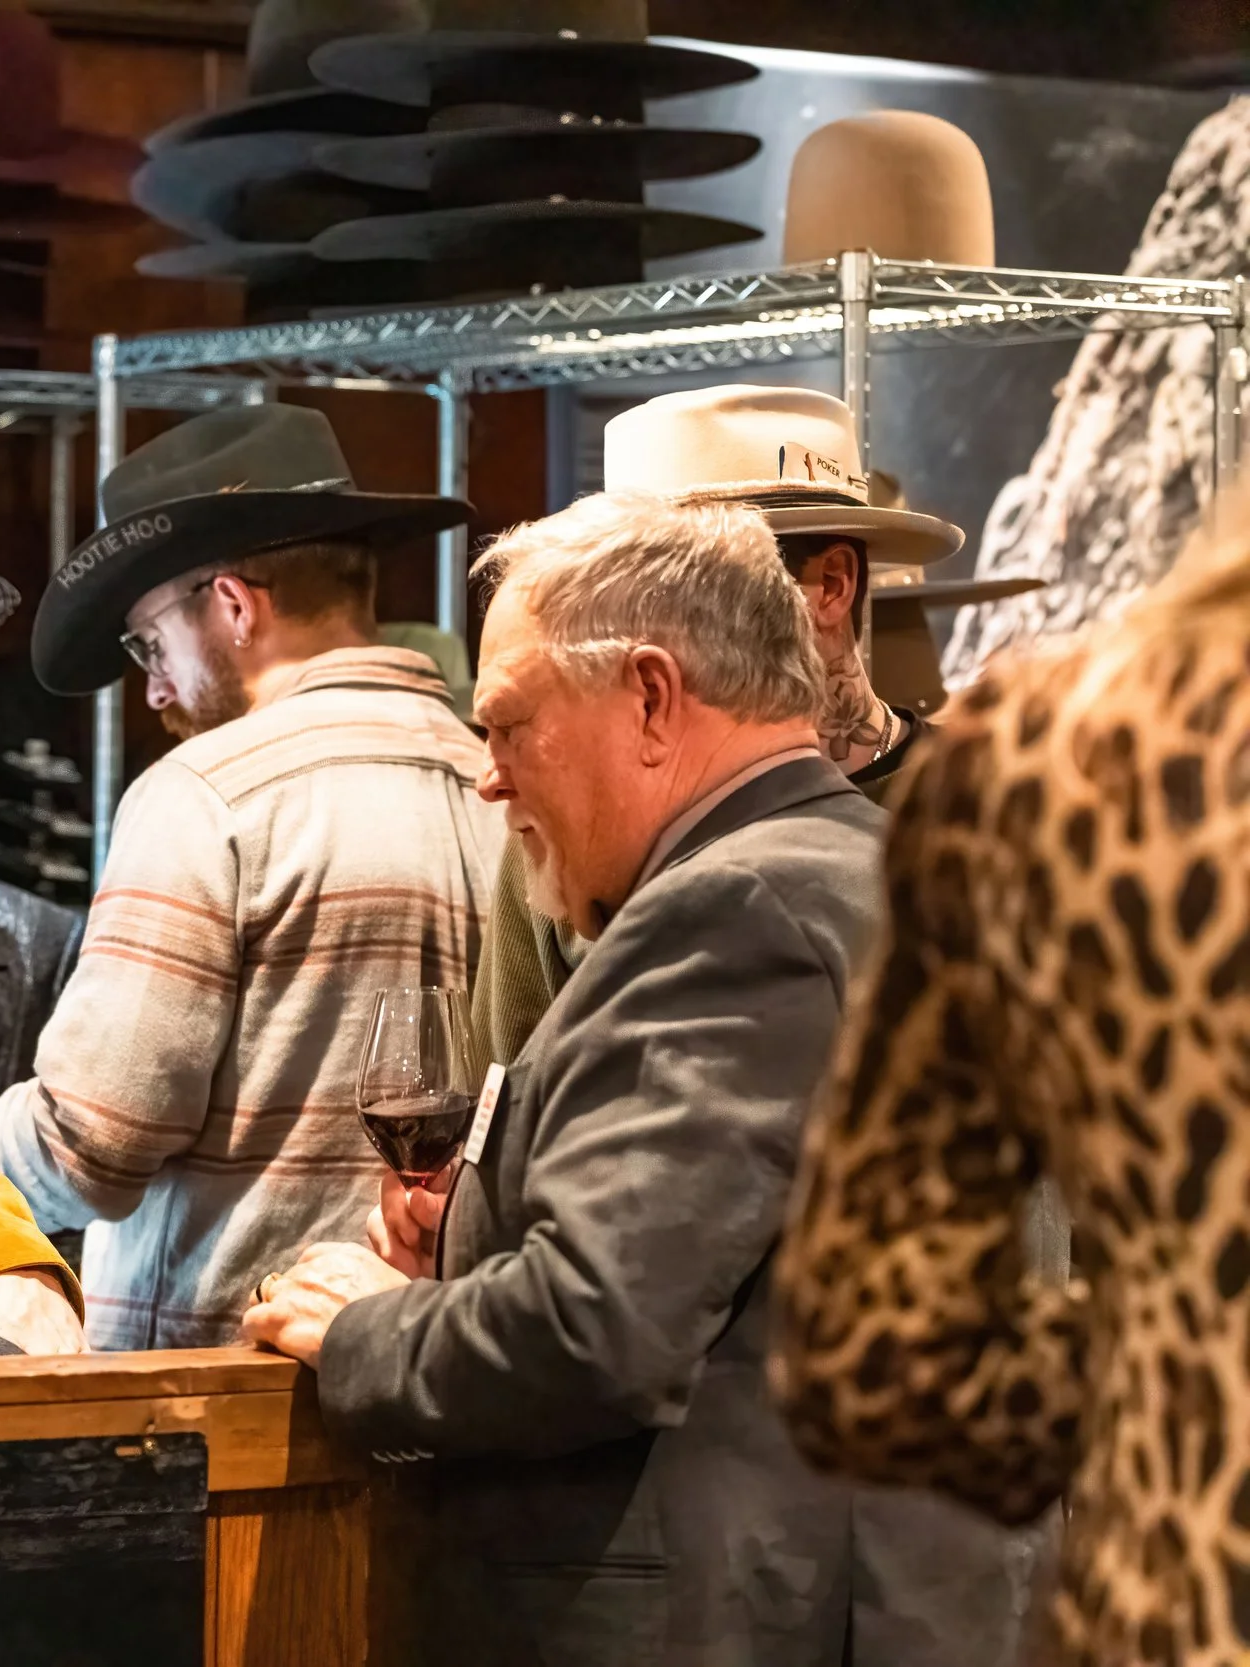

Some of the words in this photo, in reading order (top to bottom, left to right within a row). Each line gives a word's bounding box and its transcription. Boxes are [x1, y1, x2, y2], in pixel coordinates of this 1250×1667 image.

[816, 457, 840, 478] POKER
[56, 532, 124, 589] HOOTIE
[121, 513, 172, 545] HOO
